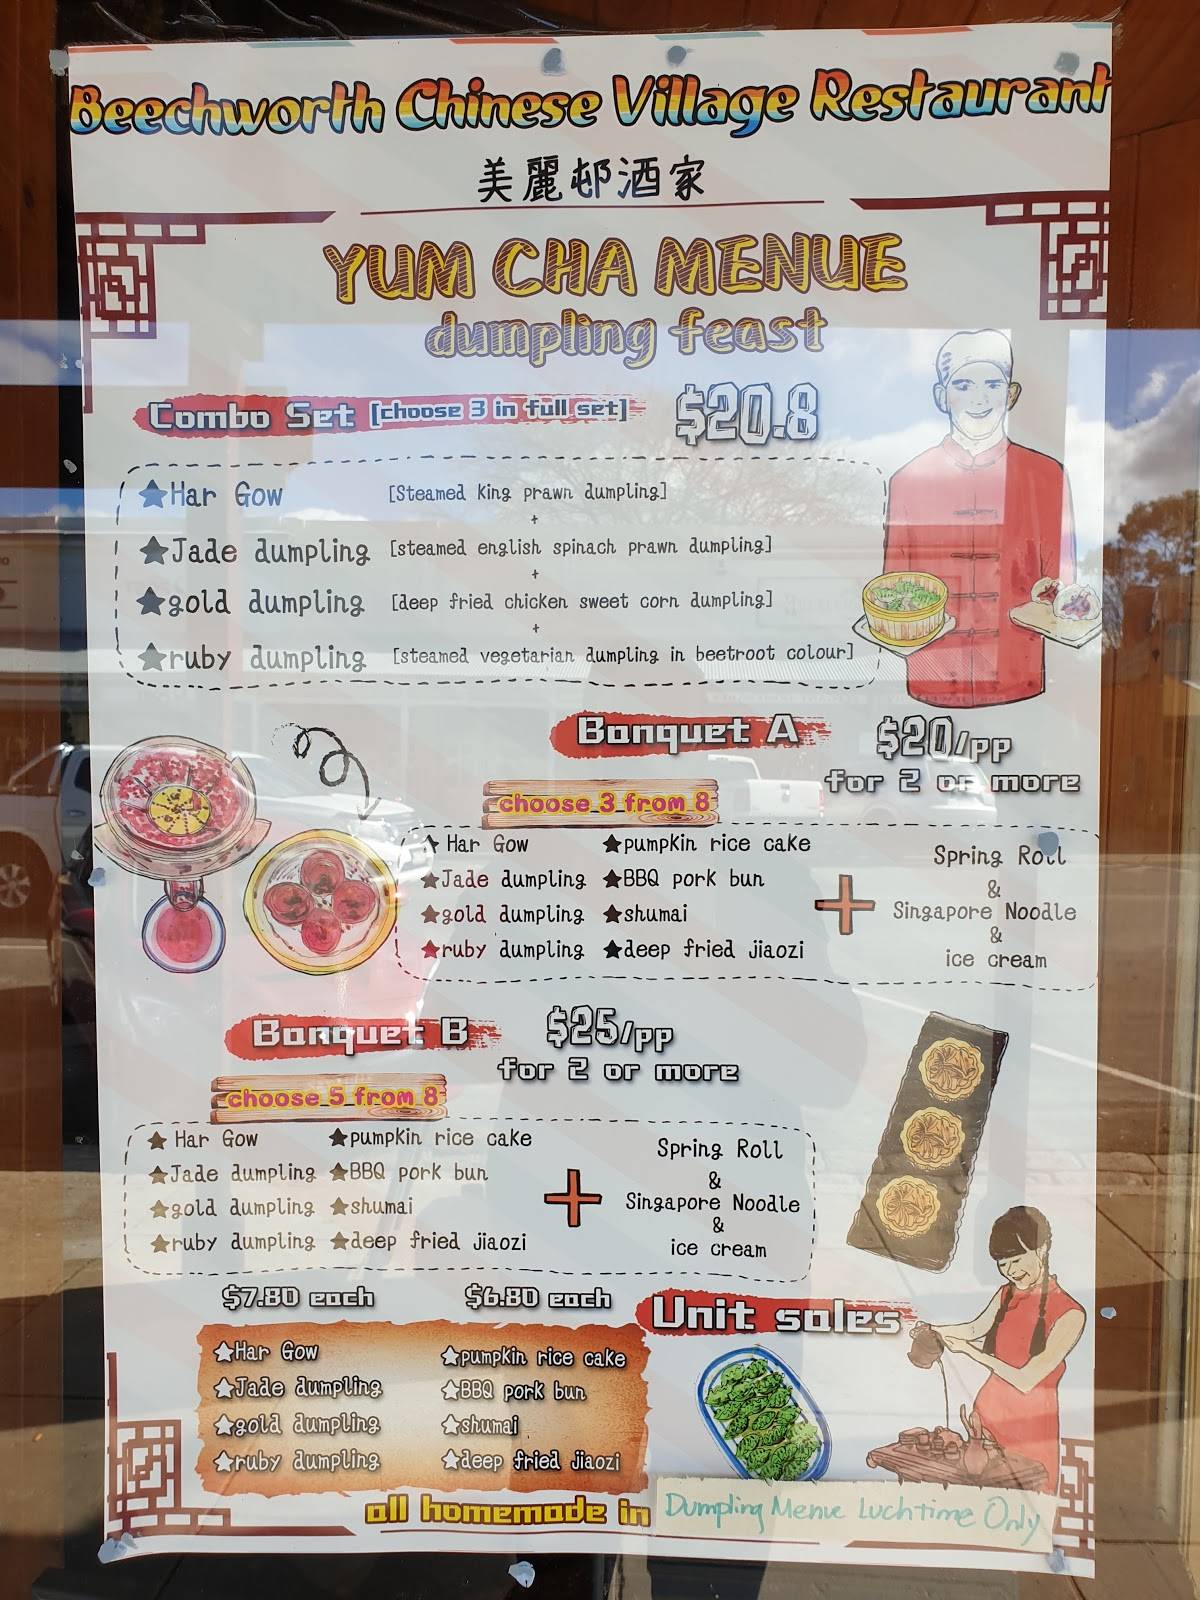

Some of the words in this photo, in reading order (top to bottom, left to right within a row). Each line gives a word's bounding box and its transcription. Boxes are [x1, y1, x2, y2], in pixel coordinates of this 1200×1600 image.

[69, 82, 385, 135] Beechworth
[396, 76, 603, 130] Chinese
[612, 73, 799, 138] Village
[810, 62, 1112, 121] Restaurant
[477, 154, 705, 203] 美麗邨酒家
[323, 240, 476, 304] YUM
[492, 237, 637, 297] CHA
[655, 232, 907, 296] MENUE
[424, 307, 657, 369] dumpling
[669, 307, 828, 354] feast
[148, 401, 271, 430] Combo
[285, 402, 356, 429] Set
[369, 400, 463, 429] [choose
[469, 399, 487, 420] 3
[494, 399, 518, 419] in
[524, 398, 568, 419] full
[575, 398, 630, 422] set]
[675, 382, 819, 446] $20.8
[170, 481, 217, 507] Har
[235, 481, 283, 507] Gow
[389, 484, 466, 503] [Steamed
[523, 485, 574, 503] prawn
[584, 481, 667, 501] dumpling]
[172, 538, 238, 563] Jade
[255, 538, 371, 567] dumpling
[390, 539, 467, 558] [steamed
[477, 538, 542, 558] english
[552, 537, 617, 557] spinach
[627, 538, 678, 556] prawn
[688, 535, 773, 556] dumpling]
[168, 589, 231, 616] gold
[249, 589, 365, 617] dumpling
[392, 594, 438, 612] [deep
[449, 592, 494, 611] fried
[504, 591, 569, 610] chicken
[579, 592, 629, 610] sweet
[639, 595, 680, 609] corn
[689, 589, 773, 610] dumpling]
[169, 645, 232, 671] ruby
[250, 644, 367, 673] dumpling
[393, 647, 469, 665] [steamed
[480, 646, 576, 666] vegetarian
[585, 644, 660, 665] dumpling
[670, 646, 685, 662] in
[695, 643, 776, 662] beetroot
[785, 643, 854, 662] colour]
[576, 715, 751, 755] Banquet
[765, 713, 799, 744] A
[876, 714, 1013, 764] $20/pp
[825, 769, 884, 793] for
[899, 768, 921, 793] 2
[937, 774, 977, 793] or
[991, 774, 1081, 793] more
[498, 793, 590, 814] choose
[599, 791, 616, 814] 3
[623, 791, 686, 813] from
[694, 790, 711, 813] 8
[447, 834, 481, 853] Har
[493, 834, 529, 853] Gow
[624, 834, 698, 855] pumpkin
[710, 834, 751, 852] rice
[763, 834, 812, 852] cake
[934, 845, 1003, 868] Spring
[441, 870, 489, 888] Jade
[501, 869, 587, 889] dumpling
[623, 869, 660, 887] BBQ
[673, 870, 717, 889] pork
[729, 869, 765, 887] bun
[987, 879, 1001, 898] &
[441, 905, 487, 925] gold
[499, 905, 585, 925] dumpling
[624, 904, 688, 922] shumai
[893, 902, 993, 922] Singapore
[1004, 901, 1077, 921] Noodle
[990, 926, 1003, 943] &
[441, 941, 486, 960] ruby
[499, 940, 585, 960] dumpling
[624, 940, 671, 960] deep
[683, 939, 735, 959] fried
[748, 940, 805, 960] jiaozi
[946, 949, 975, 967] ice
[987, 953, 1047, 969] cream
[252, 1017, 425, 1056] Banquet
[441, 1016, 469, 1046] B
[546, 1004, 674, 1053] $25/pp
[497, 1057, 554, 1081] for
[568, 1056, 589, 1081] 2
[603, 1062, 640, 1082] or
[655, 1062, 739, 1082] more
[227, 1088, 321, 1108] choose
[329, 1086, 345, 1106] 5
[354, 1085, 415, 1107] from
[423, 1085, 439, 1106] 8
[175, 1130, 209, 1149] Har
[222, 1129, 259, 1149] Gow
[350, 1128, 423, 1149] pumpkin
[435, 1128, 474, 1147] rice
[487, 1128, 532, 1147] cake
[657, 1138, 724, 1161] Spring
[736, 1138, 784, 1160] Roll
[170, 1165, 219, 1183] Jade
[231, 1164, 317, 1184] dumpling
[350, 1162, 386, 1181] BBQ
[398, 1162, 442, 1183] pork
[454, 1162, 488, 1181] bun
[708, 1172, 722, 1190] &
[171, 1199, 217, 1219] gold
[230, 1198, 316, 1218] dumpling
[350, 1197, 413, 1216] shumai
[626, 1192, 721, 1213] Singapore
[733, 1193, 801, 1214] Noodle
[712, 1216, 725, 1234] &
[171, 1233, 217, 1252] ruby
[231, 1232, 317, 1252] dumpling
[350, 1231, 397, 1252] deep
[410, 1231, 461, 1250] fried
[473, 1232, 527, 1254] jiaozi
[670, 1240, 698, 1257] ice
[710, 1242, 767, 1259] cream
[221, 1284, 300, 1311] $7.80
[309, 1286, 375, 1308] each
[464, 1283, 540, 1311] $6.80
[547, 1287, 612, 1310] each
[651, 1294, 756, 1333] Unit
[775, 1299, 902, 1335] sales
[234, 1341, 270, 1362] Har
[280, 1342, 320, 1362] Gow
[460, 1346, 528, 1370] pumpkin
[536, 1347, 574, 1368] rice
[583, 1348, 627, 1369] cake
[234, 1377, 286, 1399] Jade
[295, 1375, 383, 1400] dumpling
[460, 1380, 495, 1401] BBQ
[503, 1380, 545, 1403] pork
[553, 1381, 587, 1402] bun
[234, 1413, 282, 1436] gold
[293, 1413, 381, 1436] dumpling
[461, 1415, 520, 1436] shumai
[234, 1451, 282, 1473] ruby
[293, 1449, 381, 1472] dumpling
[461, 1452, 504, 1473] deep
[513, 1451, 561, 1472] fried
[570, 1452, 621, 1473] jiaozi
[364, 1495, 410, 1526] all
[421, 1495, 608, 1526] homemade
[618, 1499, 652, 1527] in
[663, 1491, 765, 1535] Dumpling
[983, 1495, 1042, 1547] Only
